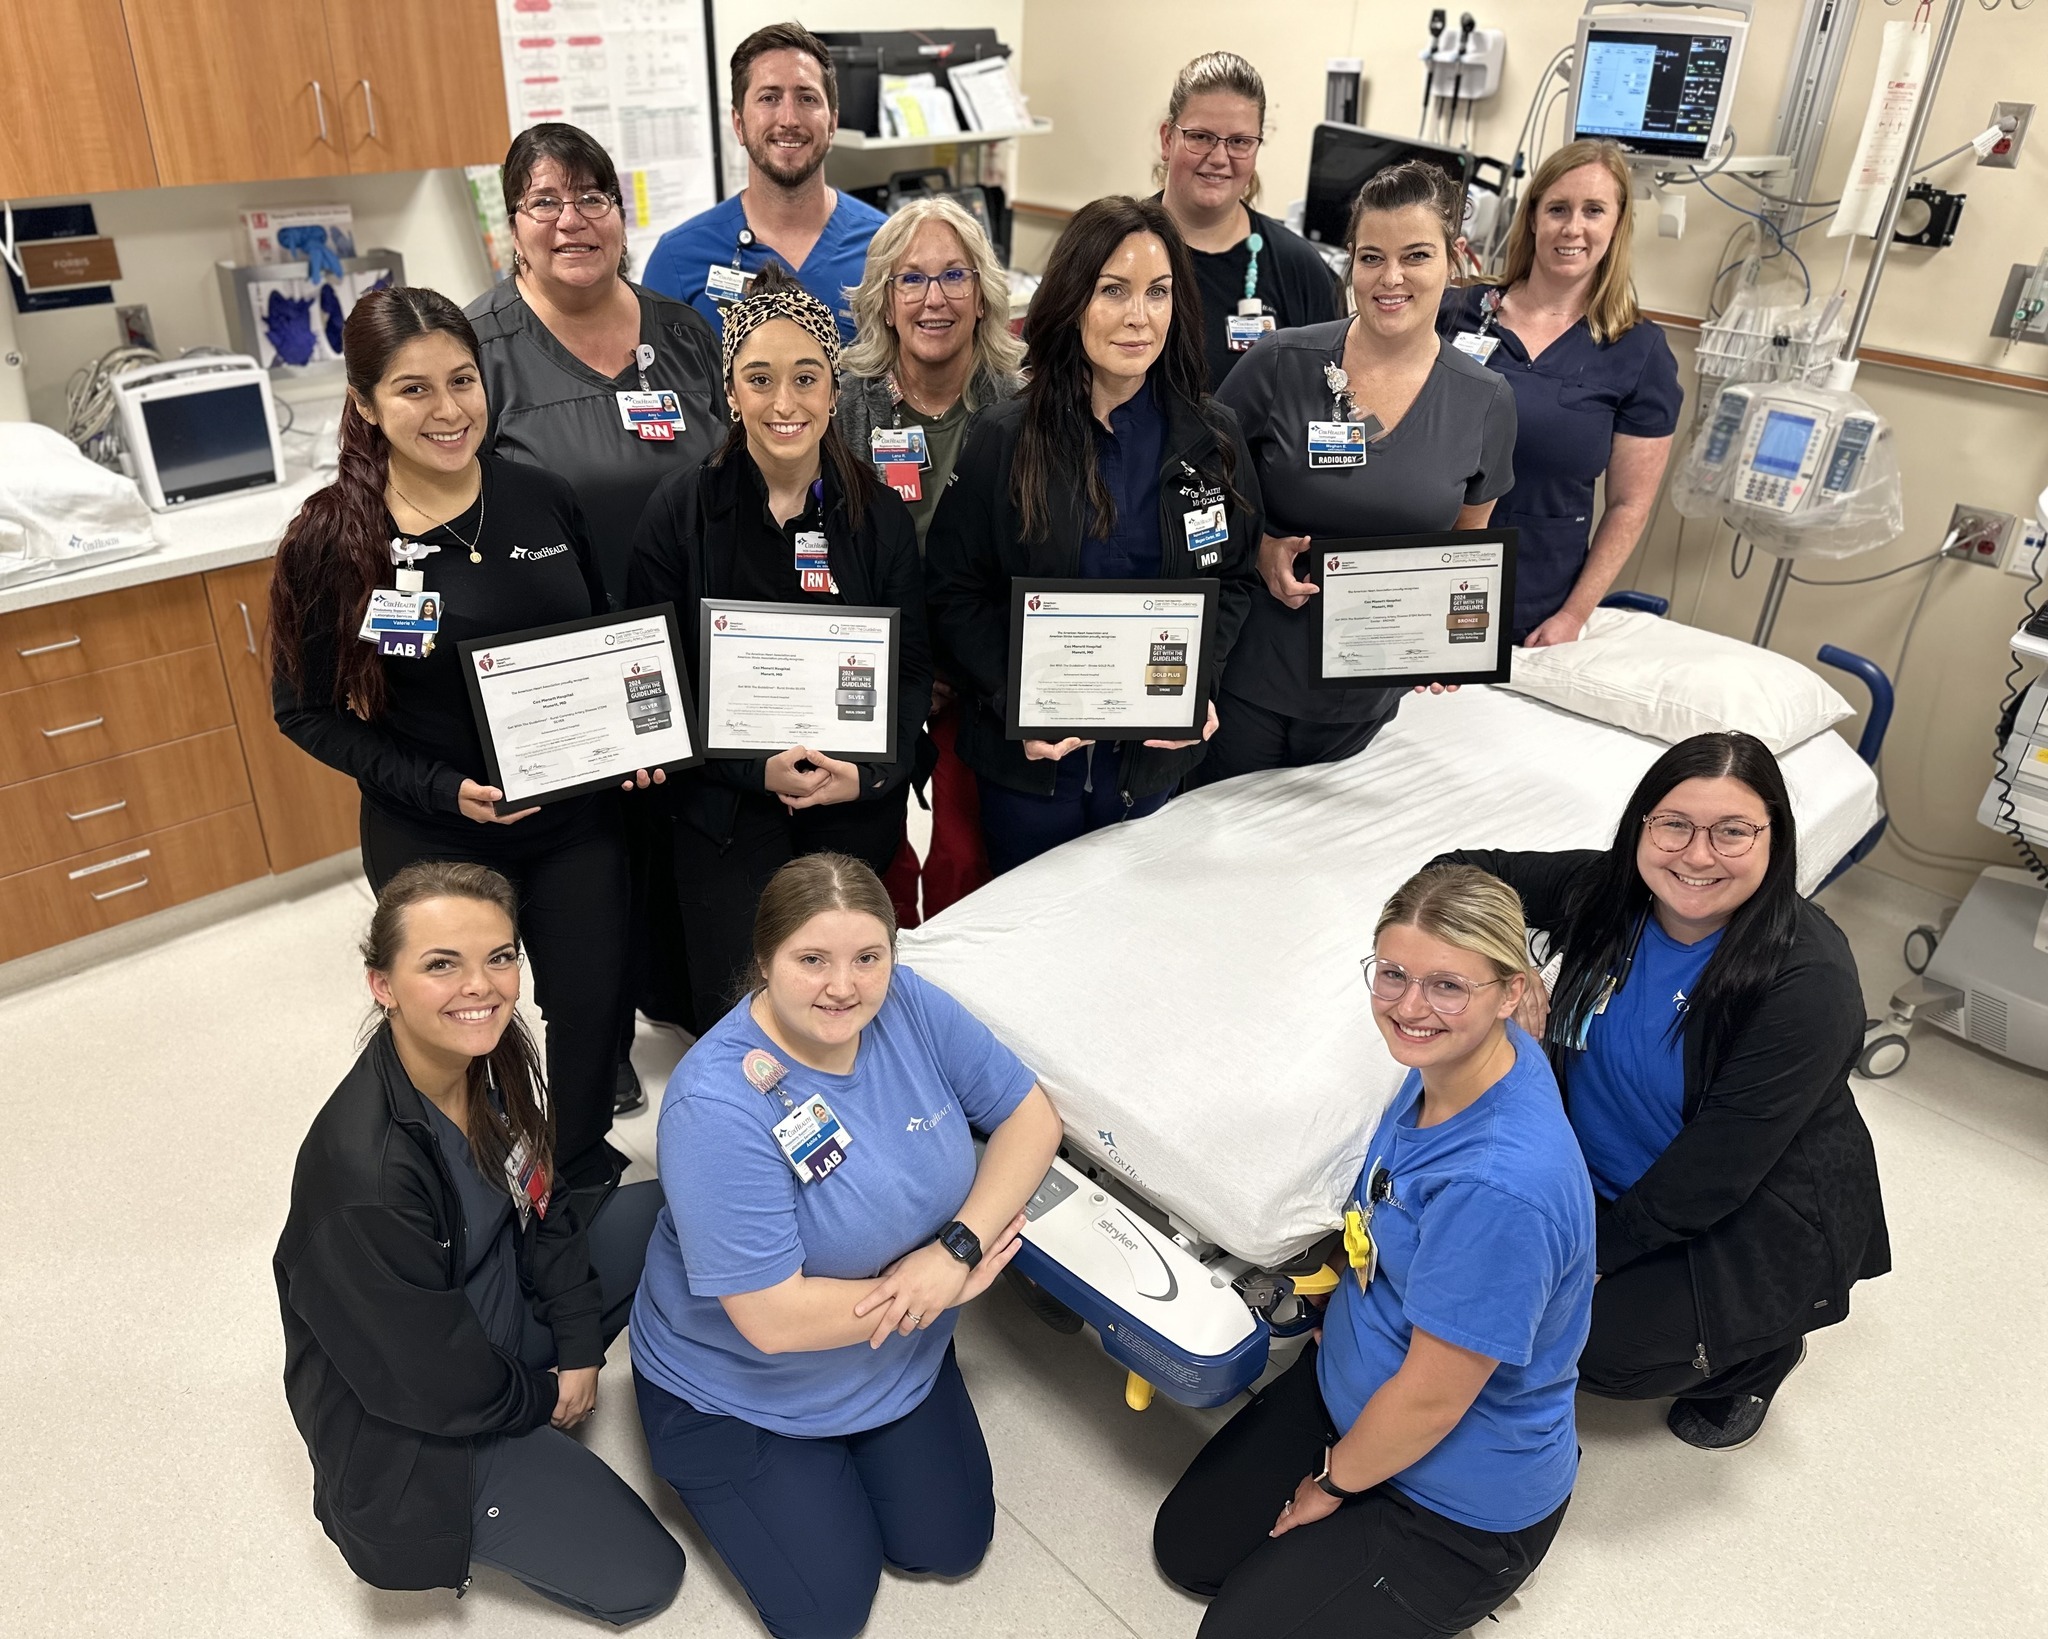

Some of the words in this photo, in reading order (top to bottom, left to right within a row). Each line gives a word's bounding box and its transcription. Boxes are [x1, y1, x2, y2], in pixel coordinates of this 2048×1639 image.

[640, 424, 670, 437] RN
[1319, 456, 1357, 464] RADIOLOGY
[1201, 551, 1218, 567] MD
[808, 572, 823, 587] RN
[383, 641, 416, 657] LAB
[628, 679, 641, 687] 2024
[631, 688, 662, 699] GUIDELINES
[640, 702, 658, 711] SILVER
[815, 1149, 842, 1179] LAB
[1098, 1220, 1138, 1250] stryker
